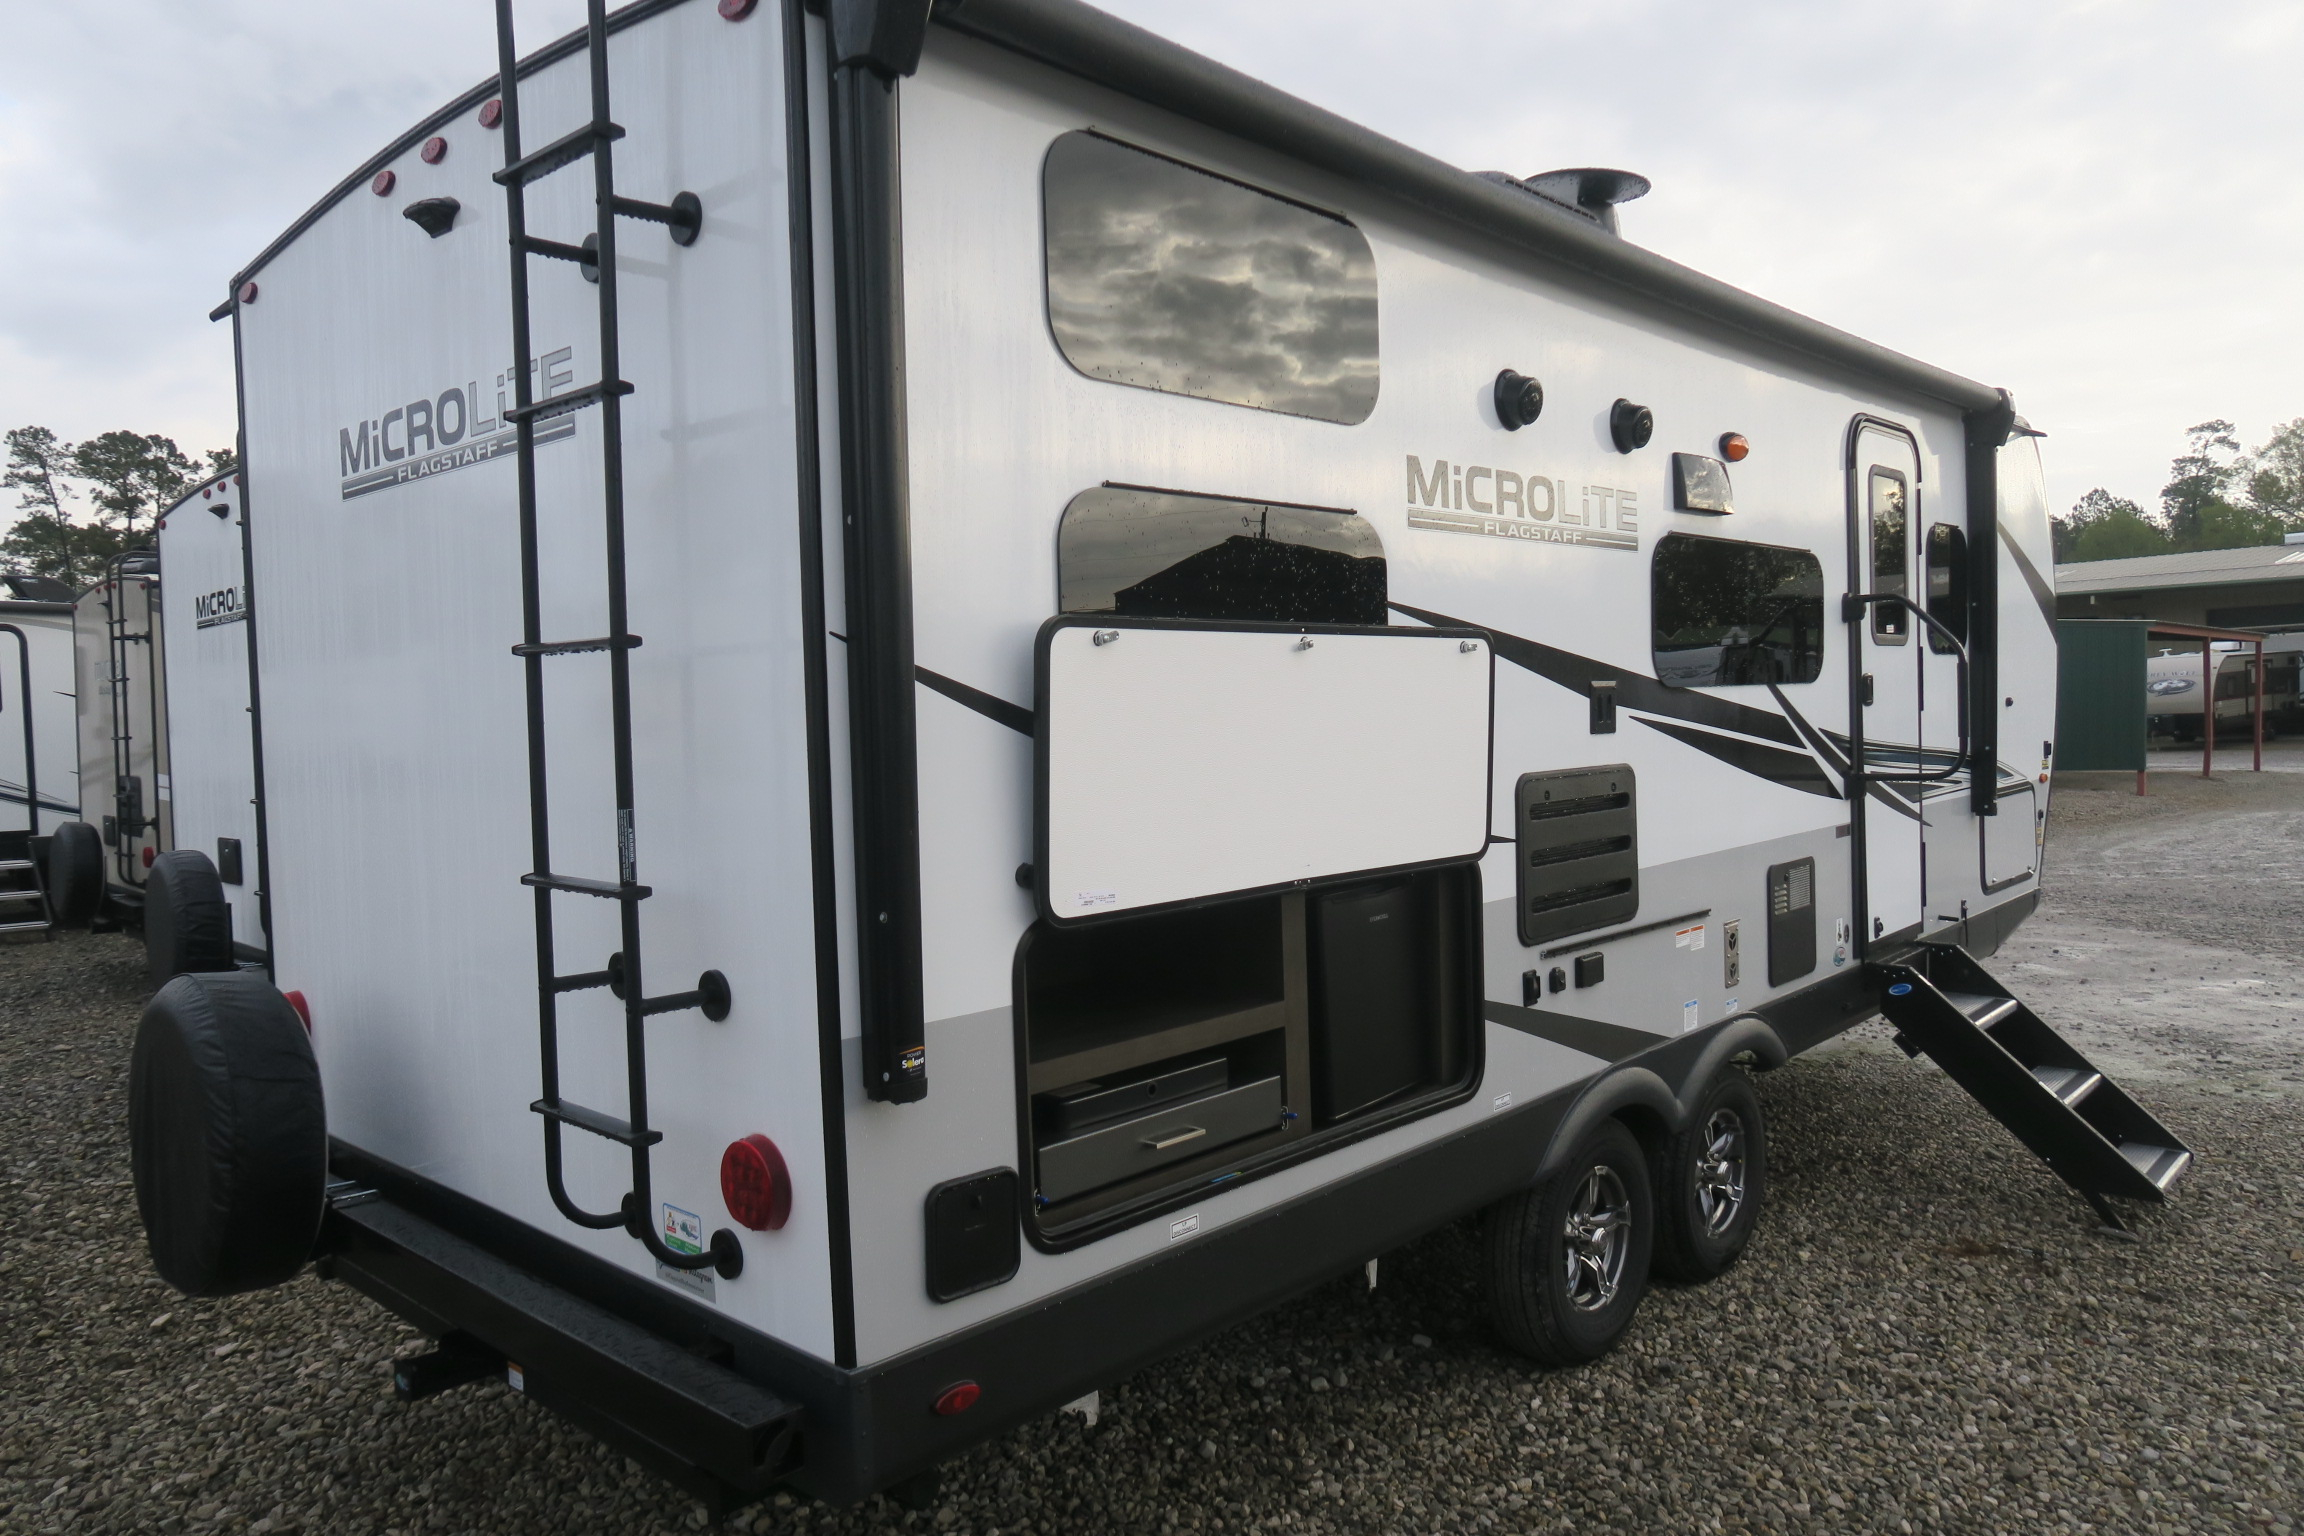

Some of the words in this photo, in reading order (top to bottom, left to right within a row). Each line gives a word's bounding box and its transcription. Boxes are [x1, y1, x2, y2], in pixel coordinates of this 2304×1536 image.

[397, 440, 498, 483] FLAGSTAFF
[1406, 454, 1638, 533] MiCROLiTE
[1484, 520, 1582, 544] FLAGSTAFF
[901, 1056, 925, 1069] Solero
